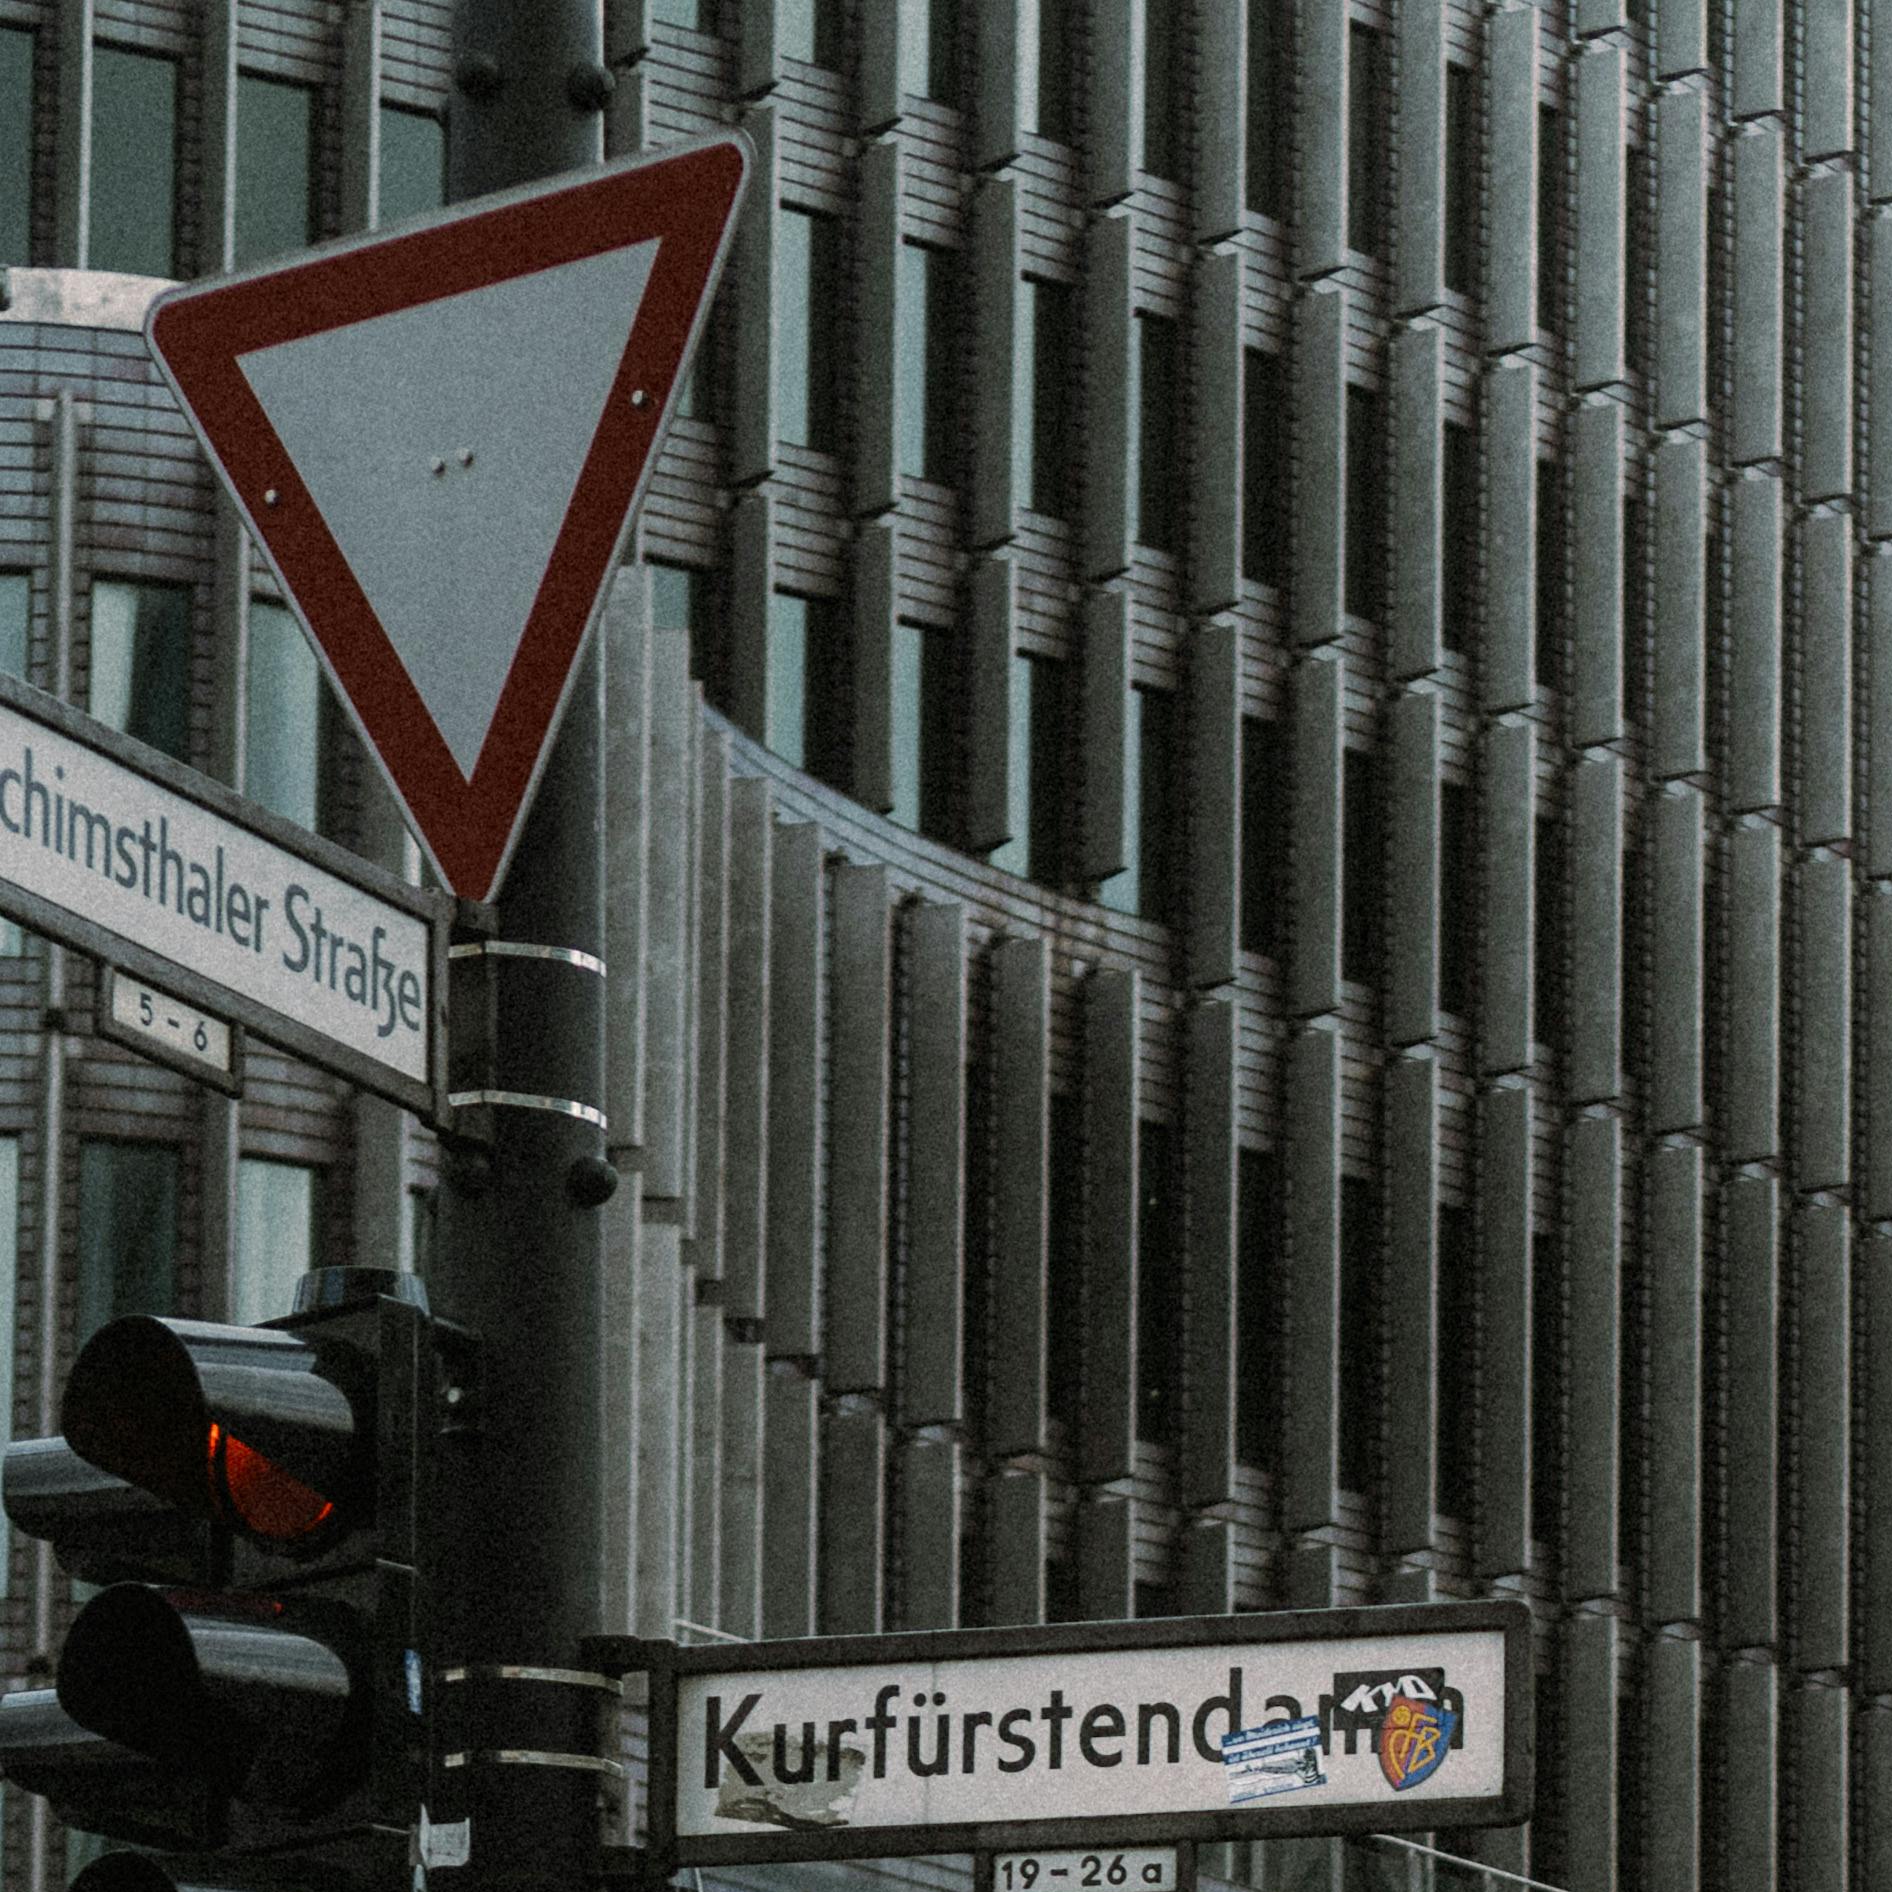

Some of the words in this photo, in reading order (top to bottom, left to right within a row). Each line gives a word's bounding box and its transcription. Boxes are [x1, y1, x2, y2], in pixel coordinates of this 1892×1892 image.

[0, 746, 270, 954] chimsthaler
[282, 883, 422, 1038] Straße
[140, 991, 154, 1027] 5
[193, 1020, 209, 1053] 6
[1003, 1857, 1038, 1891] 19
[1082, 1853, 1128, 1887] 26
[1141, 1864, 1163, 1885] a
